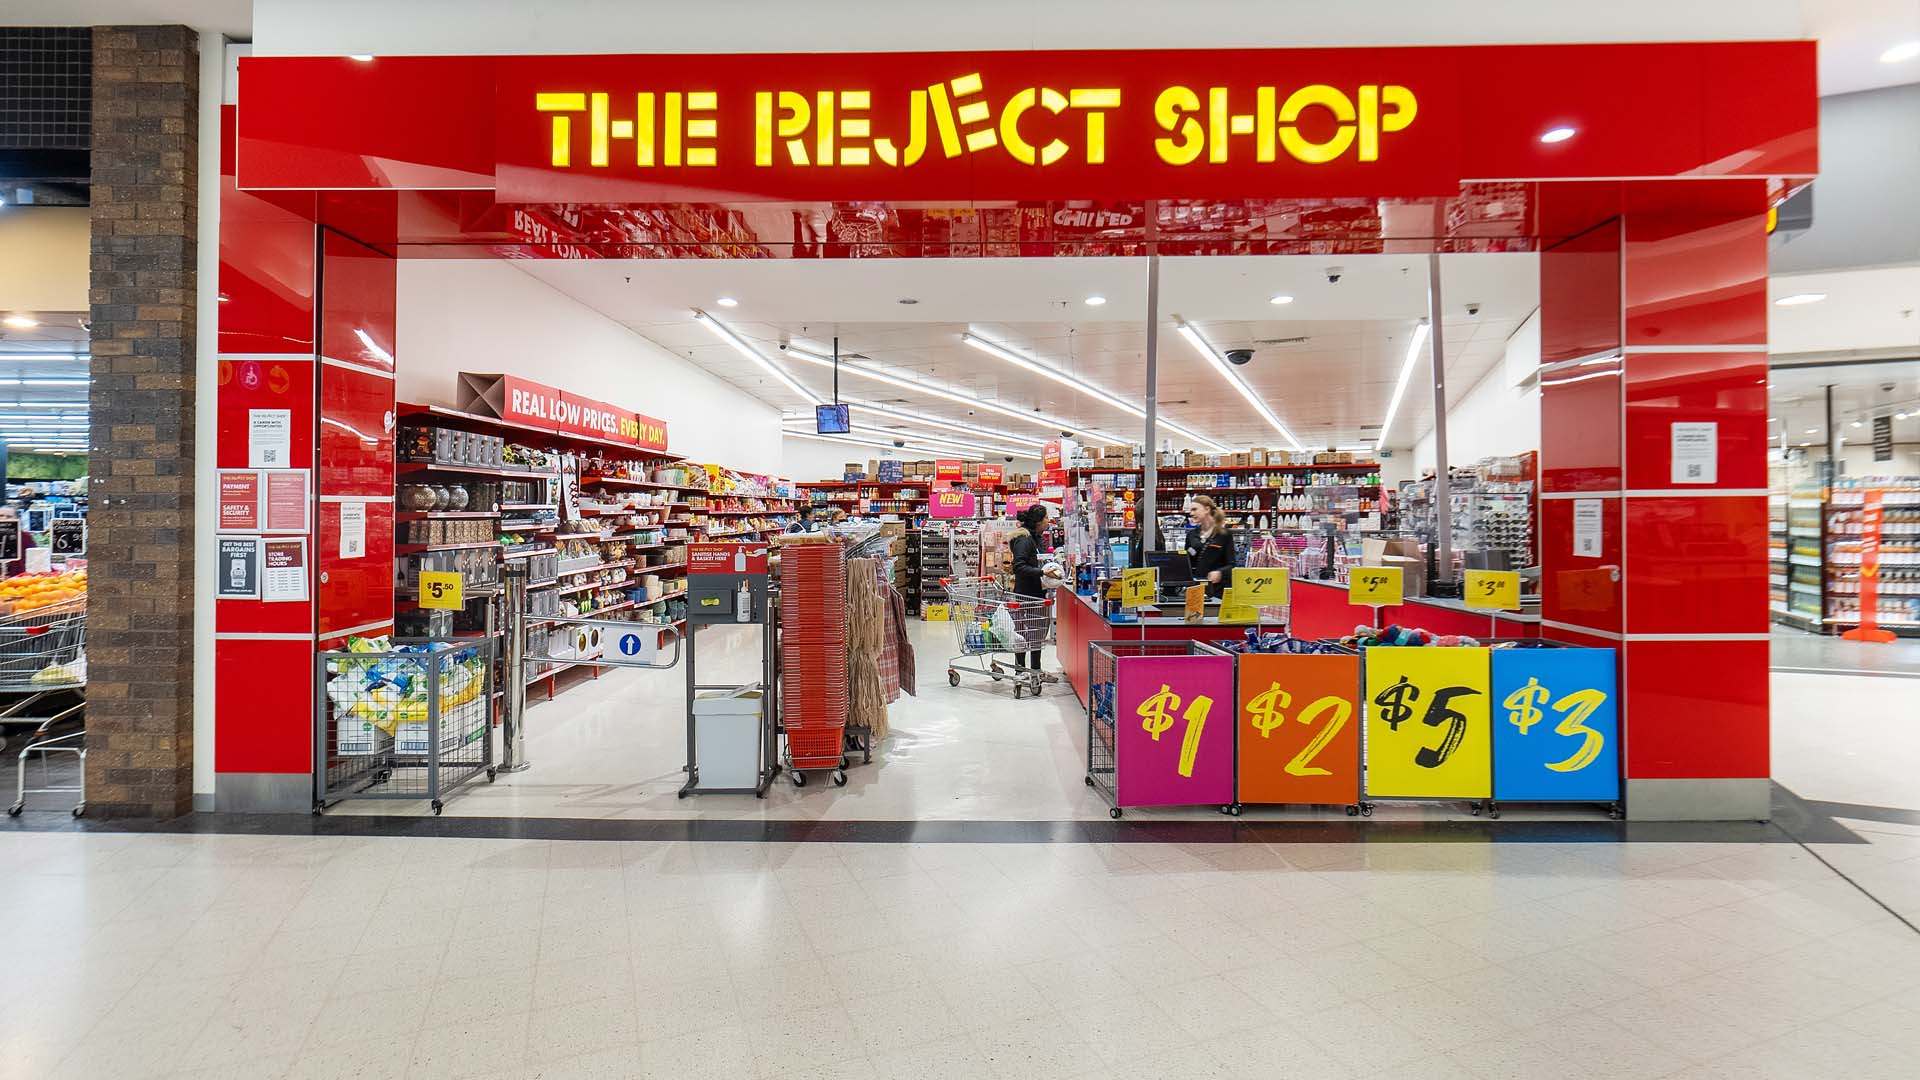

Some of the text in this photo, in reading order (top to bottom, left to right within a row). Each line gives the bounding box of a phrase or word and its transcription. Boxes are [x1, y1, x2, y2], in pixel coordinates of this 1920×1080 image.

[536, 72, 1418, 168] THE REJECT SHOP
[511, 388, 547, 419] REAL
[549, 398, 581, 426] LOW
[582, 407, 619, 434] PRICES.
[648, 424, 665, 445] DAY.
[939, 493, 964, 504] NEW!
[426, 581, 454, 599] $5.50
[1128, 579, 1147, 597] $1.00
[1136, 684, 1214, 778] $1
[1245, 681, 1352, 777] $2
[1374, 675, 1482, 769] $5
[1503, 677, 1607, 772] $3
